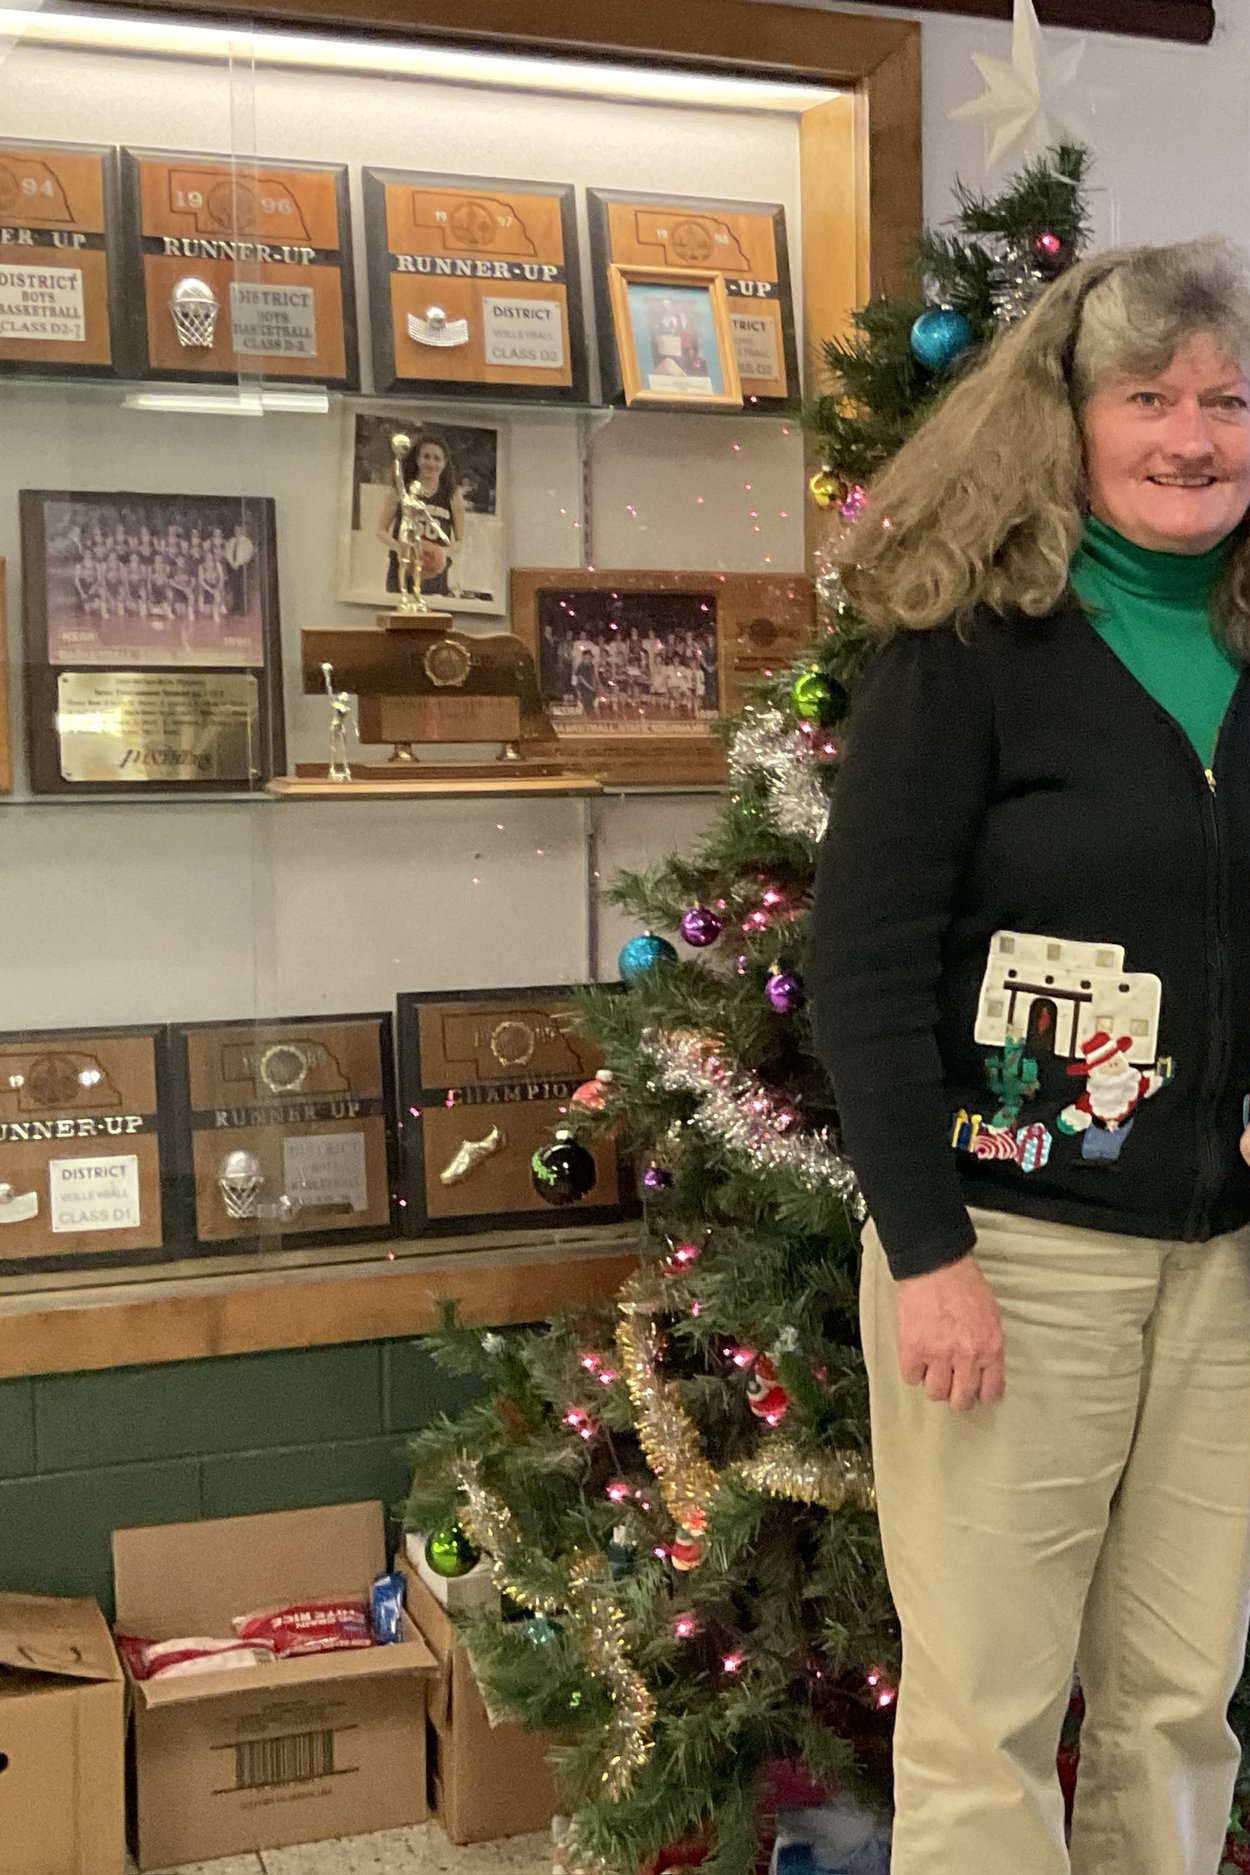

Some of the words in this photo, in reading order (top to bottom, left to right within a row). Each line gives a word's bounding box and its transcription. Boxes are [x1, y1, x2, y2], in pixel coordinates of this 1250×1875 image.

[21, 177, 54, 196] 94
[175, 190, 203, 208] 19
[261, 197, 292, 214] 96
[162, 235, 316, 266] RUNNER-UP
[398, 255, 559, 282] RUNNER-UP
[0, 272, 77, 291] DISTRICT
[21, 289, 56, 303] BOYS
[493, 305, 552, 321] DISTRICT
[732, 319, 767, 334] TRICT
[491, 346, 537, 361] CLASS
[453, 1082, 578, 1105] CHAMPIO
[61, 1165, 128, 1181] DISTRICT
[59, 1210, 109, 1226] CLASS
